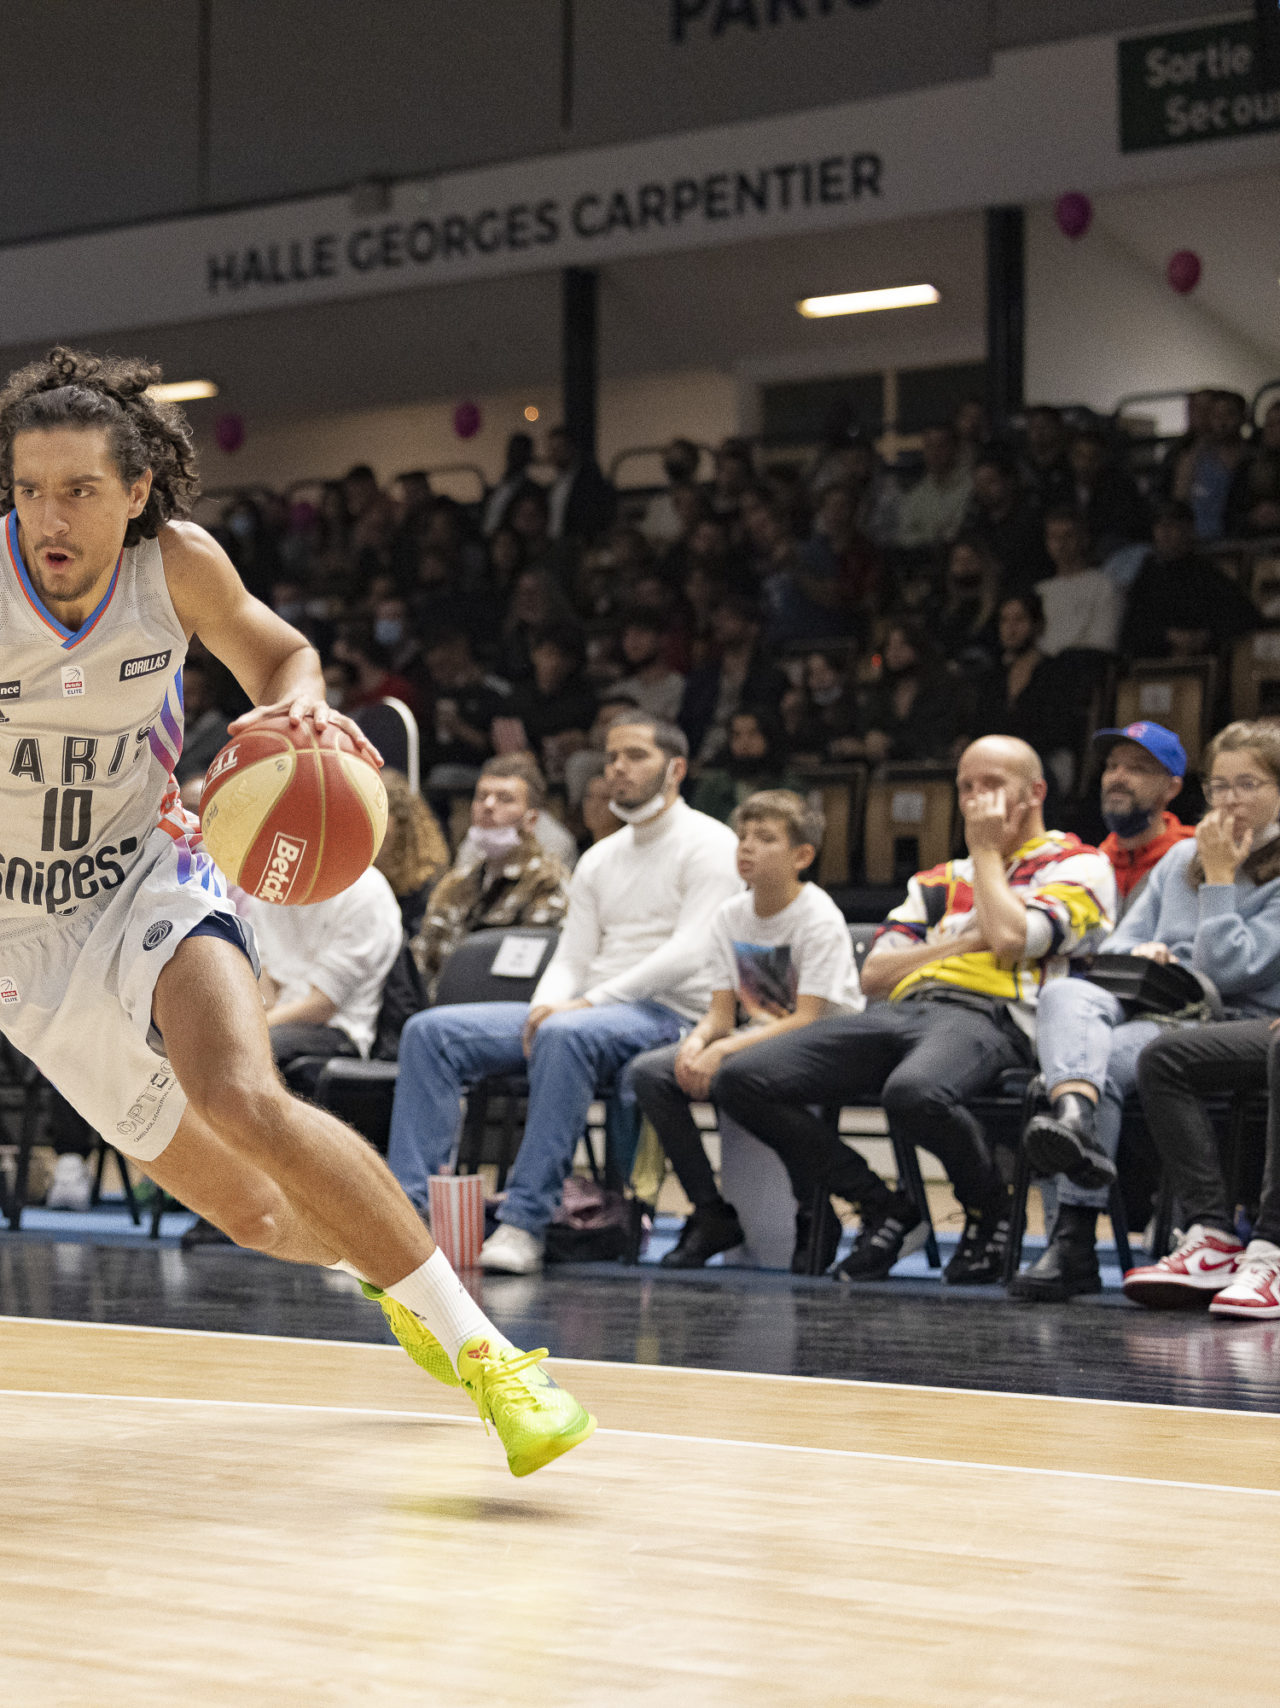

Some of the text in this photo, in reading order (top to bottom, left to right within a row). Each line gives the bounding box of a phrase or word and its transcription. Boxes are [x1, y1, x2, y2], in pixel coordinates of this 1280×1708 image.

[1144, 38, 1254, 88] Sortie
[206, 151, 884, 294] HALLE GEORGES CARPENTIER
[124, 654, 167, 677] GORILLAS
[41, 788, 93, 852] 10
